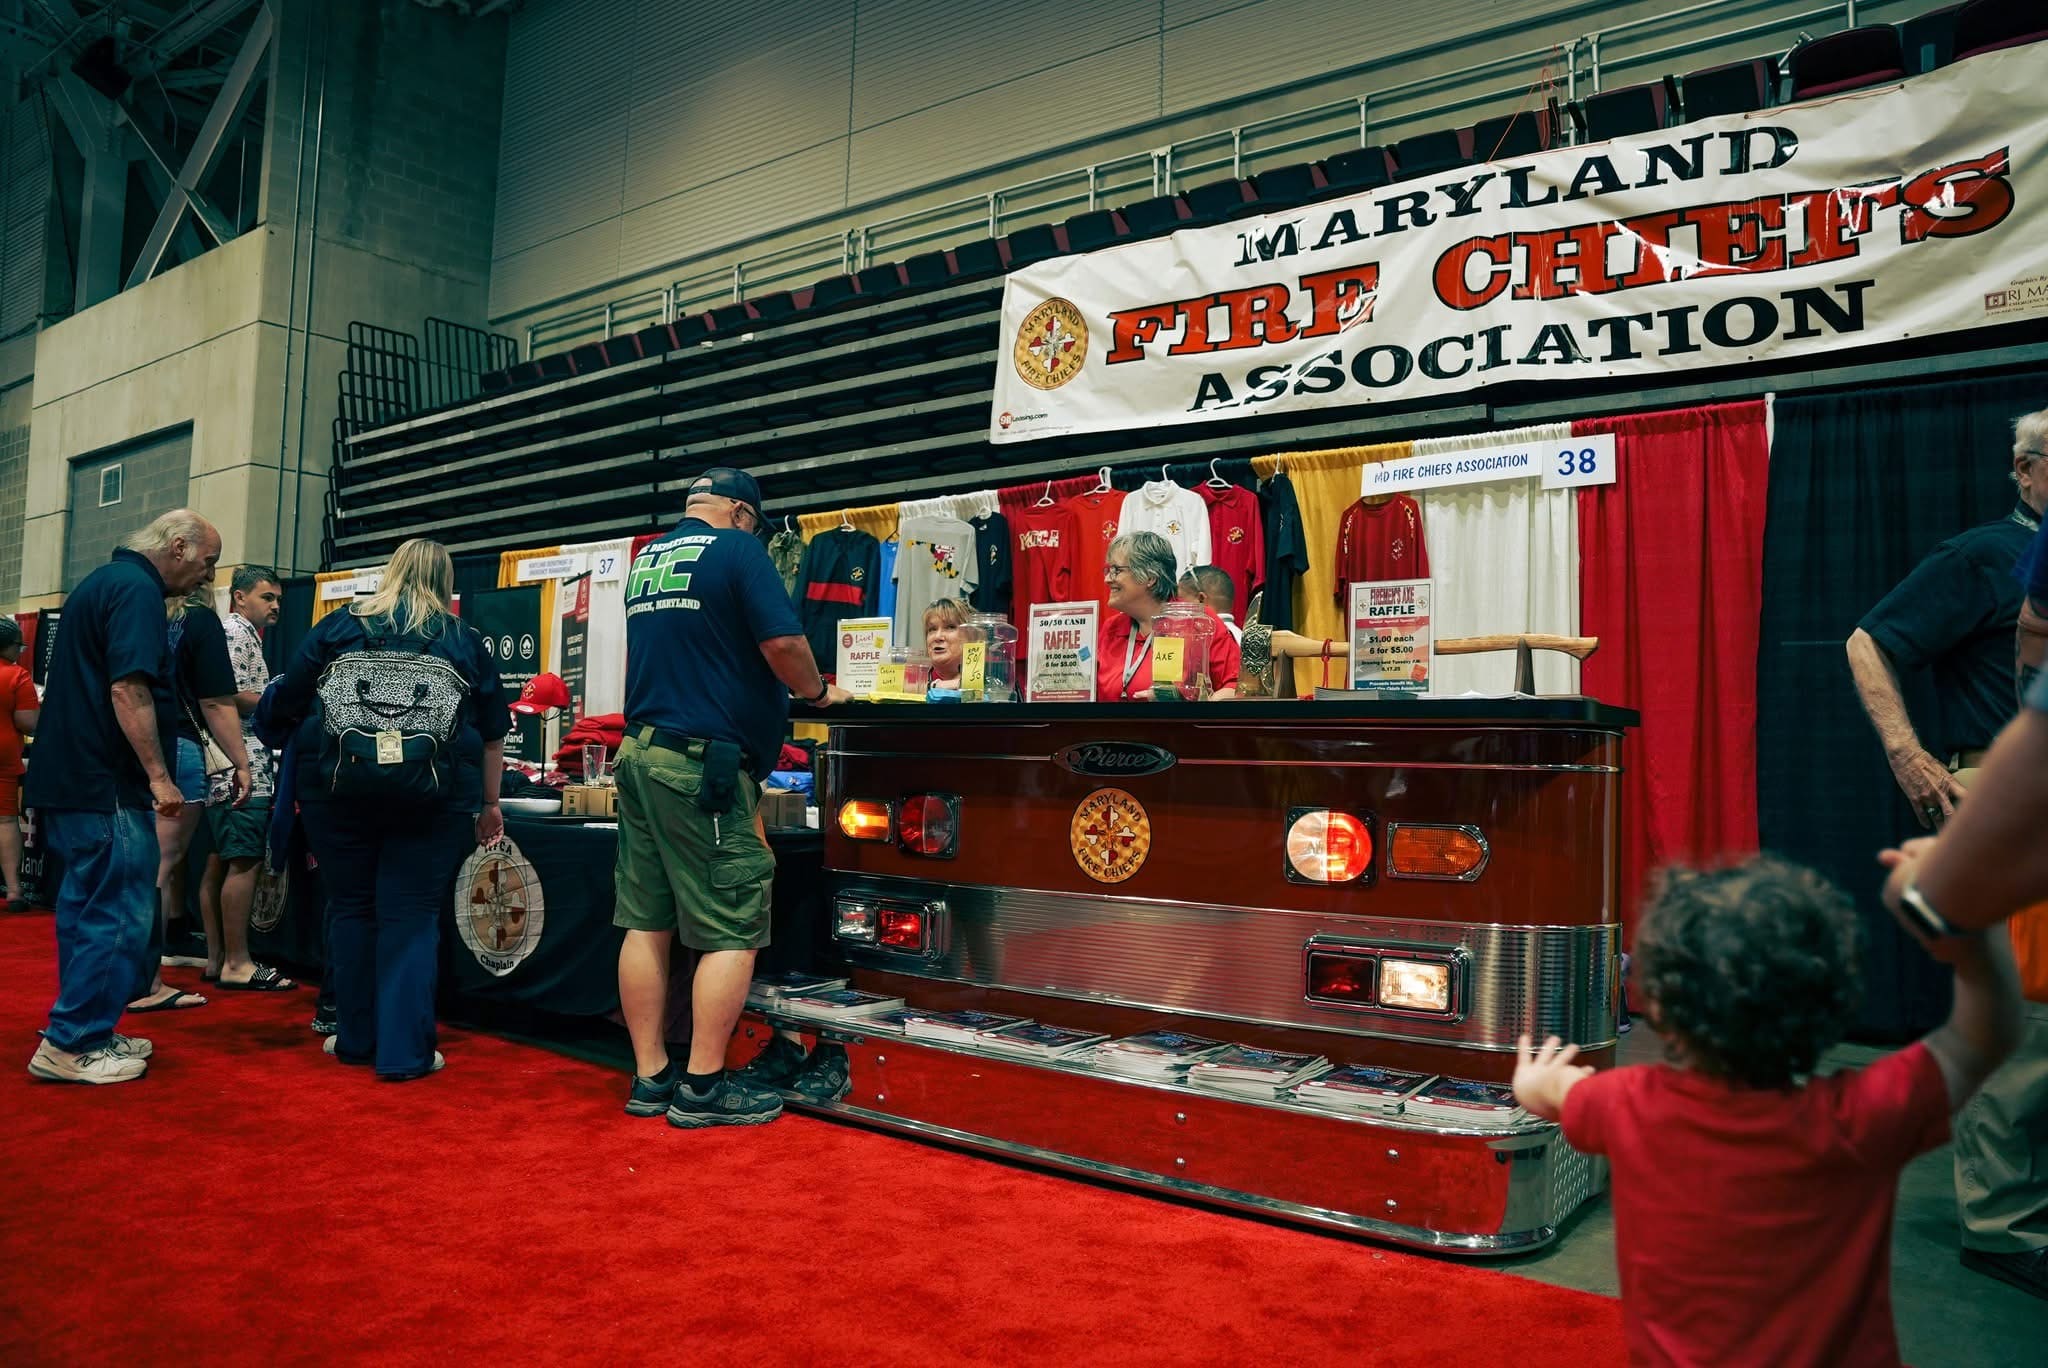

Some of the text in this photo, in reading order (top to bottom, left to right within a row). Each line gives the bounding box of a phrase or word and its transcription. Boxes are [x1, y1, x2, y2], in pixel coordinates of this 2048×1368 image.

[1234, 126, 1799, 267] MARYLAND
[1106, 145, 2015, 365] FIRE CHIEFS
[2008, 289, 2021, 300] RJ
[1025, 303, 1080, 334] MARYLAND
[1187, 279, 1875, 412] ASSOCIATION
[1021, 354, 1081, 385] FIRE CHIEFS
[1374, 453, 1528, 484] MD FIRE CHIEFS ASSOCIATION
[1558, 448, 1597, 476] 38
[599, 558, 614, 574] 37
[655, 598, 701, 610] MARYLAND
[1403, 586, 1415, 604] AXE
[1369, 605, 1415, 616] RAFFLE
[1040, 617, 1086, 627] 50/50 CASH
[1044, 630, 1080, 650] RAFFLE
[1369, 635, 1391, 643] $1.00
[850, 651, 880, 660] RAFFLE
[1391, 646, 1413, 654] $5.00
[503, 732, 523, 744] yland
[1080, 745, 1146, 769] Pierce
[1080, 792, 1142, 822] MARYLAND
[1078, 847, 1140, 878] FIRE CHIEFS
[480, 954, 514, 971] Chaplain
